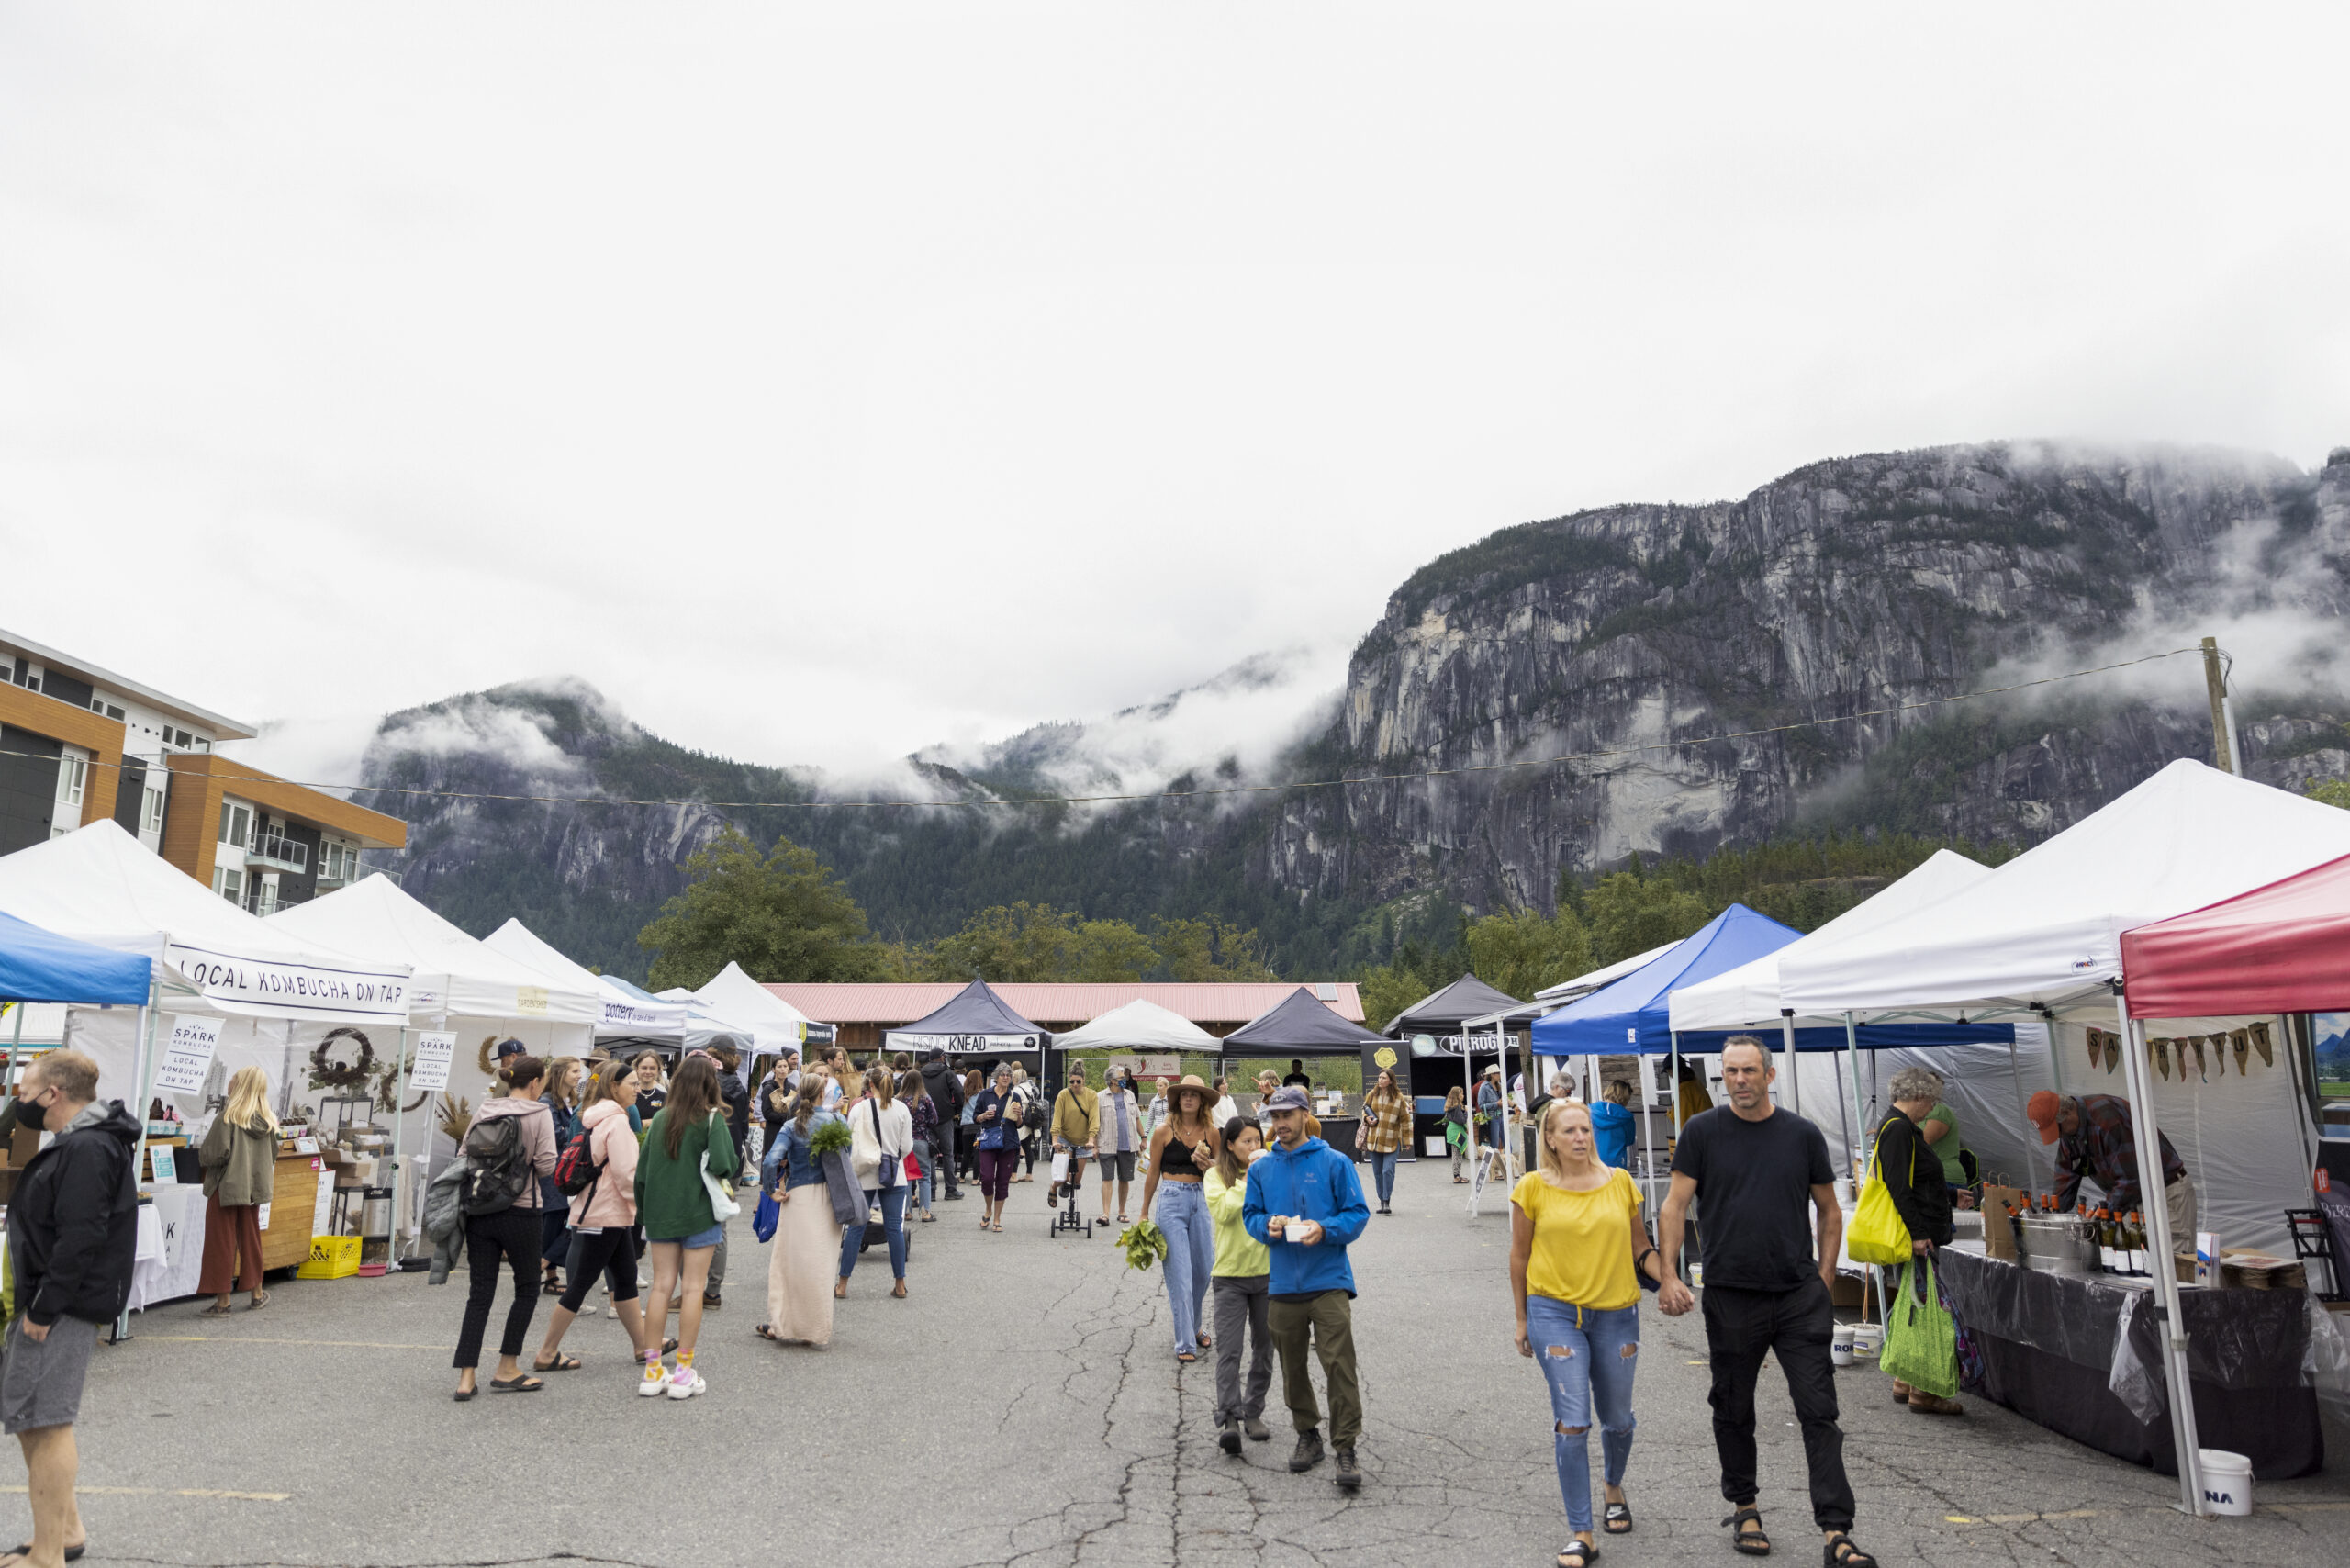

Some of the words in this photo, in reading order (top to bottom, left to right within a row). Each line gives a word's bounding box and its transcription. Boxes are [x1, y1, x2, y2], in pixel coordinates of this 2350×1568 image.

[258, 972, 350, 1001] KOMBUCHA
[356, 982, 375, 1002] ON
[379, 985, 402, 1004] TAP
[605, 1003, 635, 1024] pottery
[174, 1028, 216, 1043] SPARK
[173, 1039, 211, 1049] KOMBUCHA
[420, 1041, 453, 1050] SPARK
[913, 1036, 945, 1050] RISING
[948, 1036, 986, 1051] KNEAD
[1449, 1036, 1502, 1051] PIROG
[2090, 1028, 2266, 1059] SARKRAUT
[173, 1058, 198, 1066] LOCAL
[162, 1065, 204, 1077] KOMBUCHA
